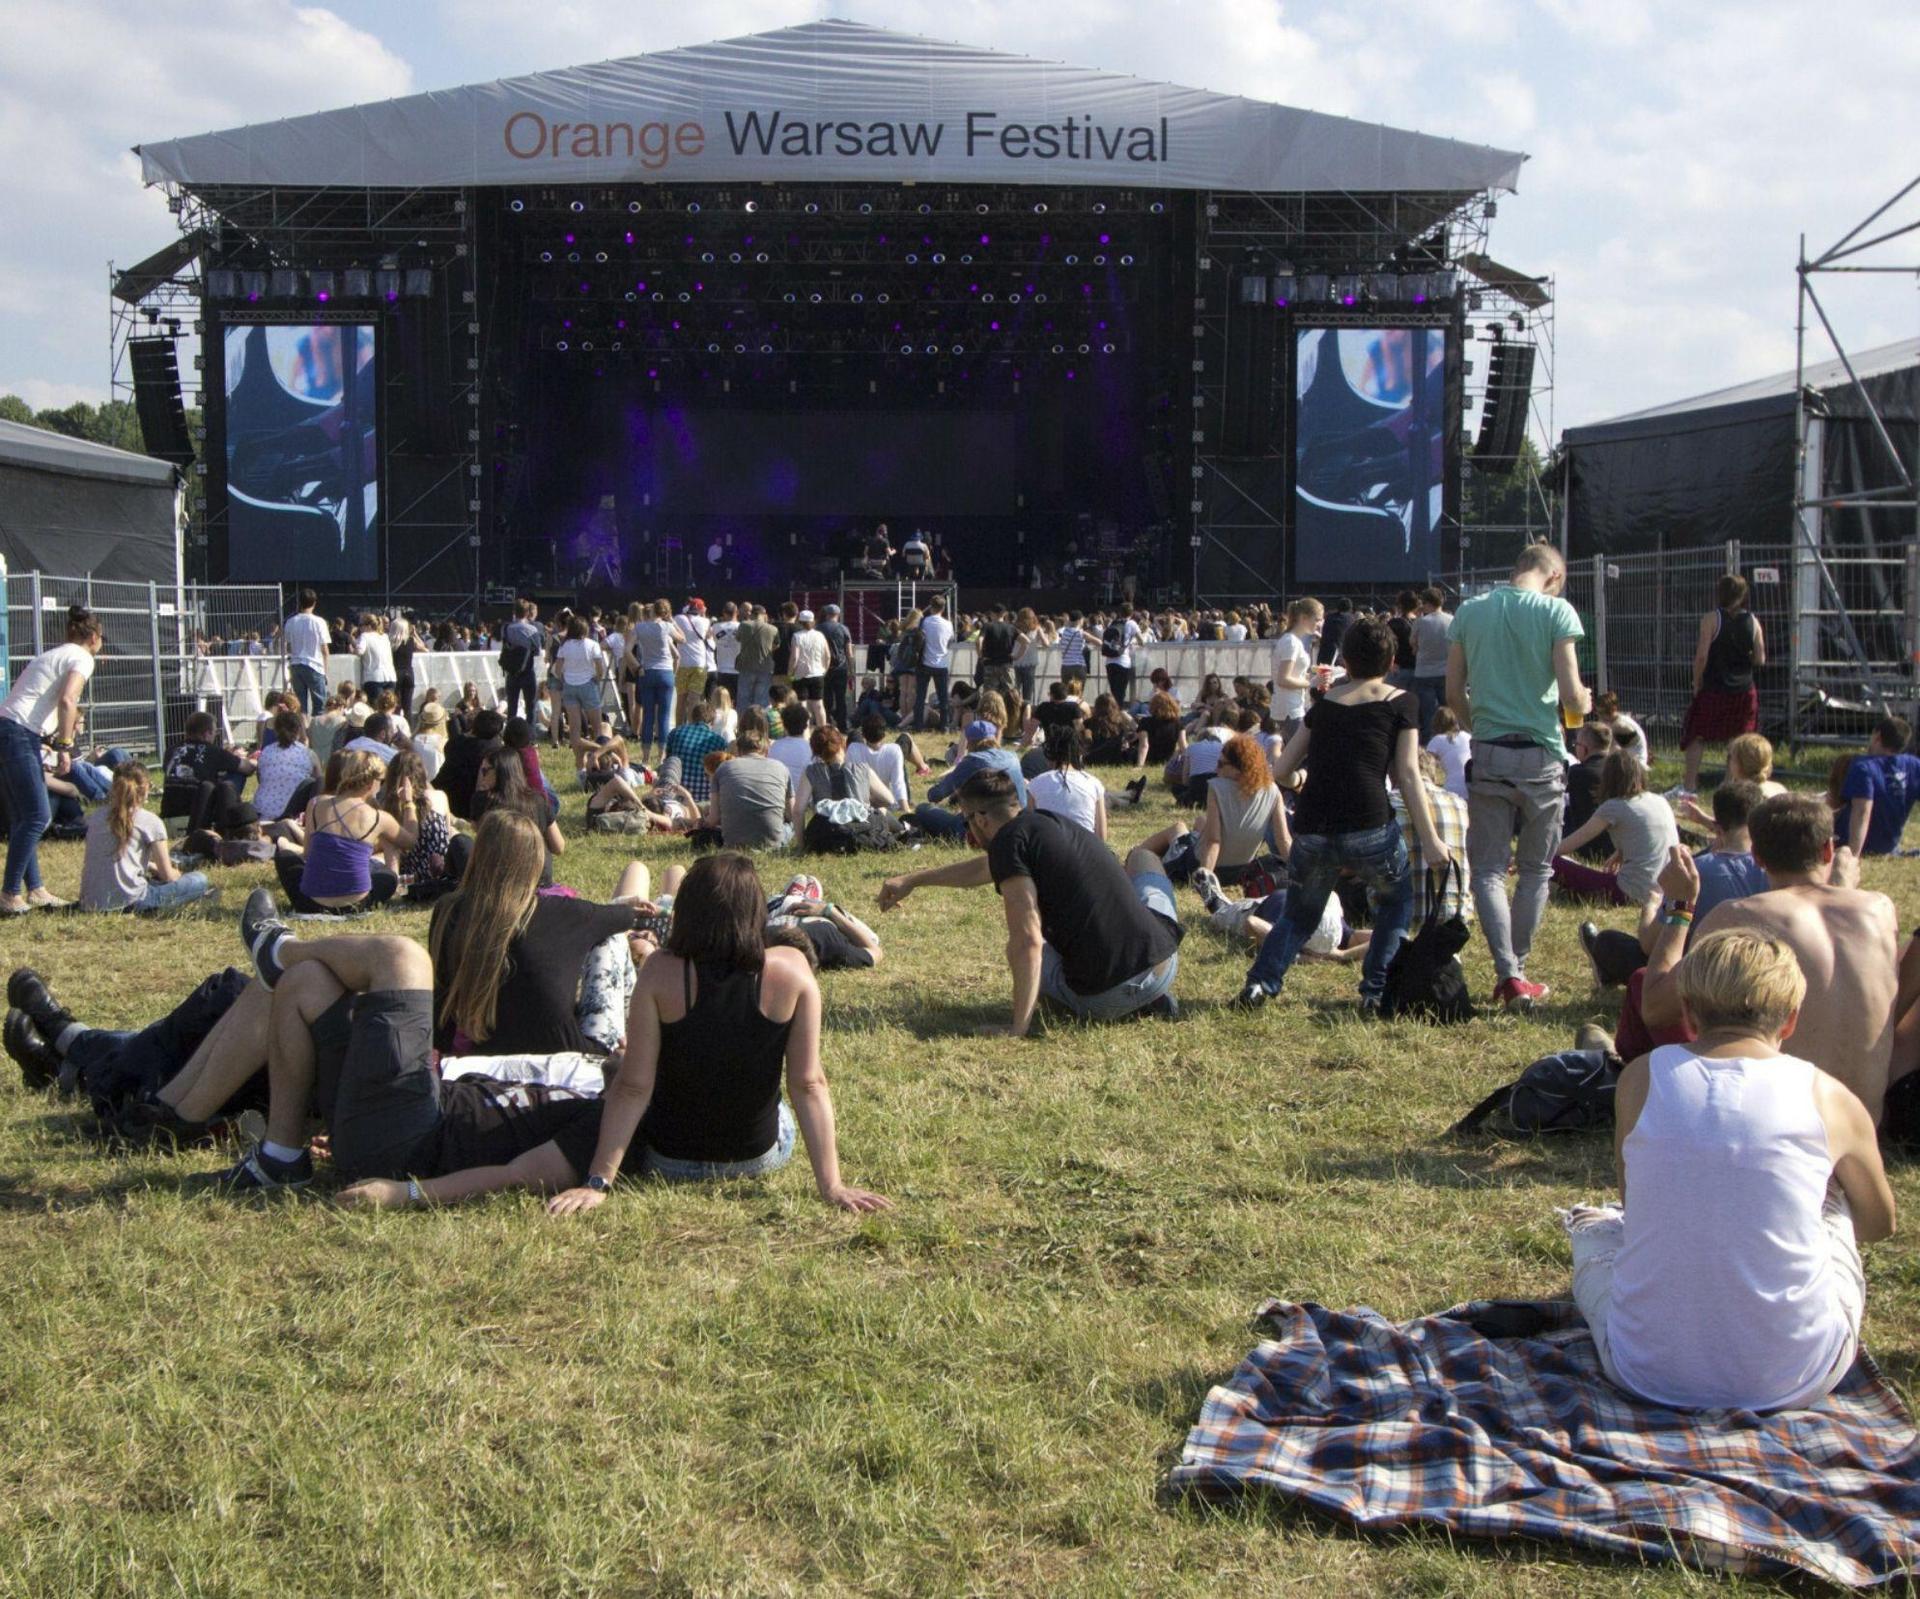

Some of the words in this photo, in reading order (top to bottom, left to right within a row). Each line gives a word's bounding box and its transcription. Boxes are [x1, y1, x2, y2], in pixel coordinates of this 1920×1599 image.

[504, 111, 705, 169] Orange
[724, 110, 945, 157] Warsaw
[966, 112, 1168, 162] Festival
